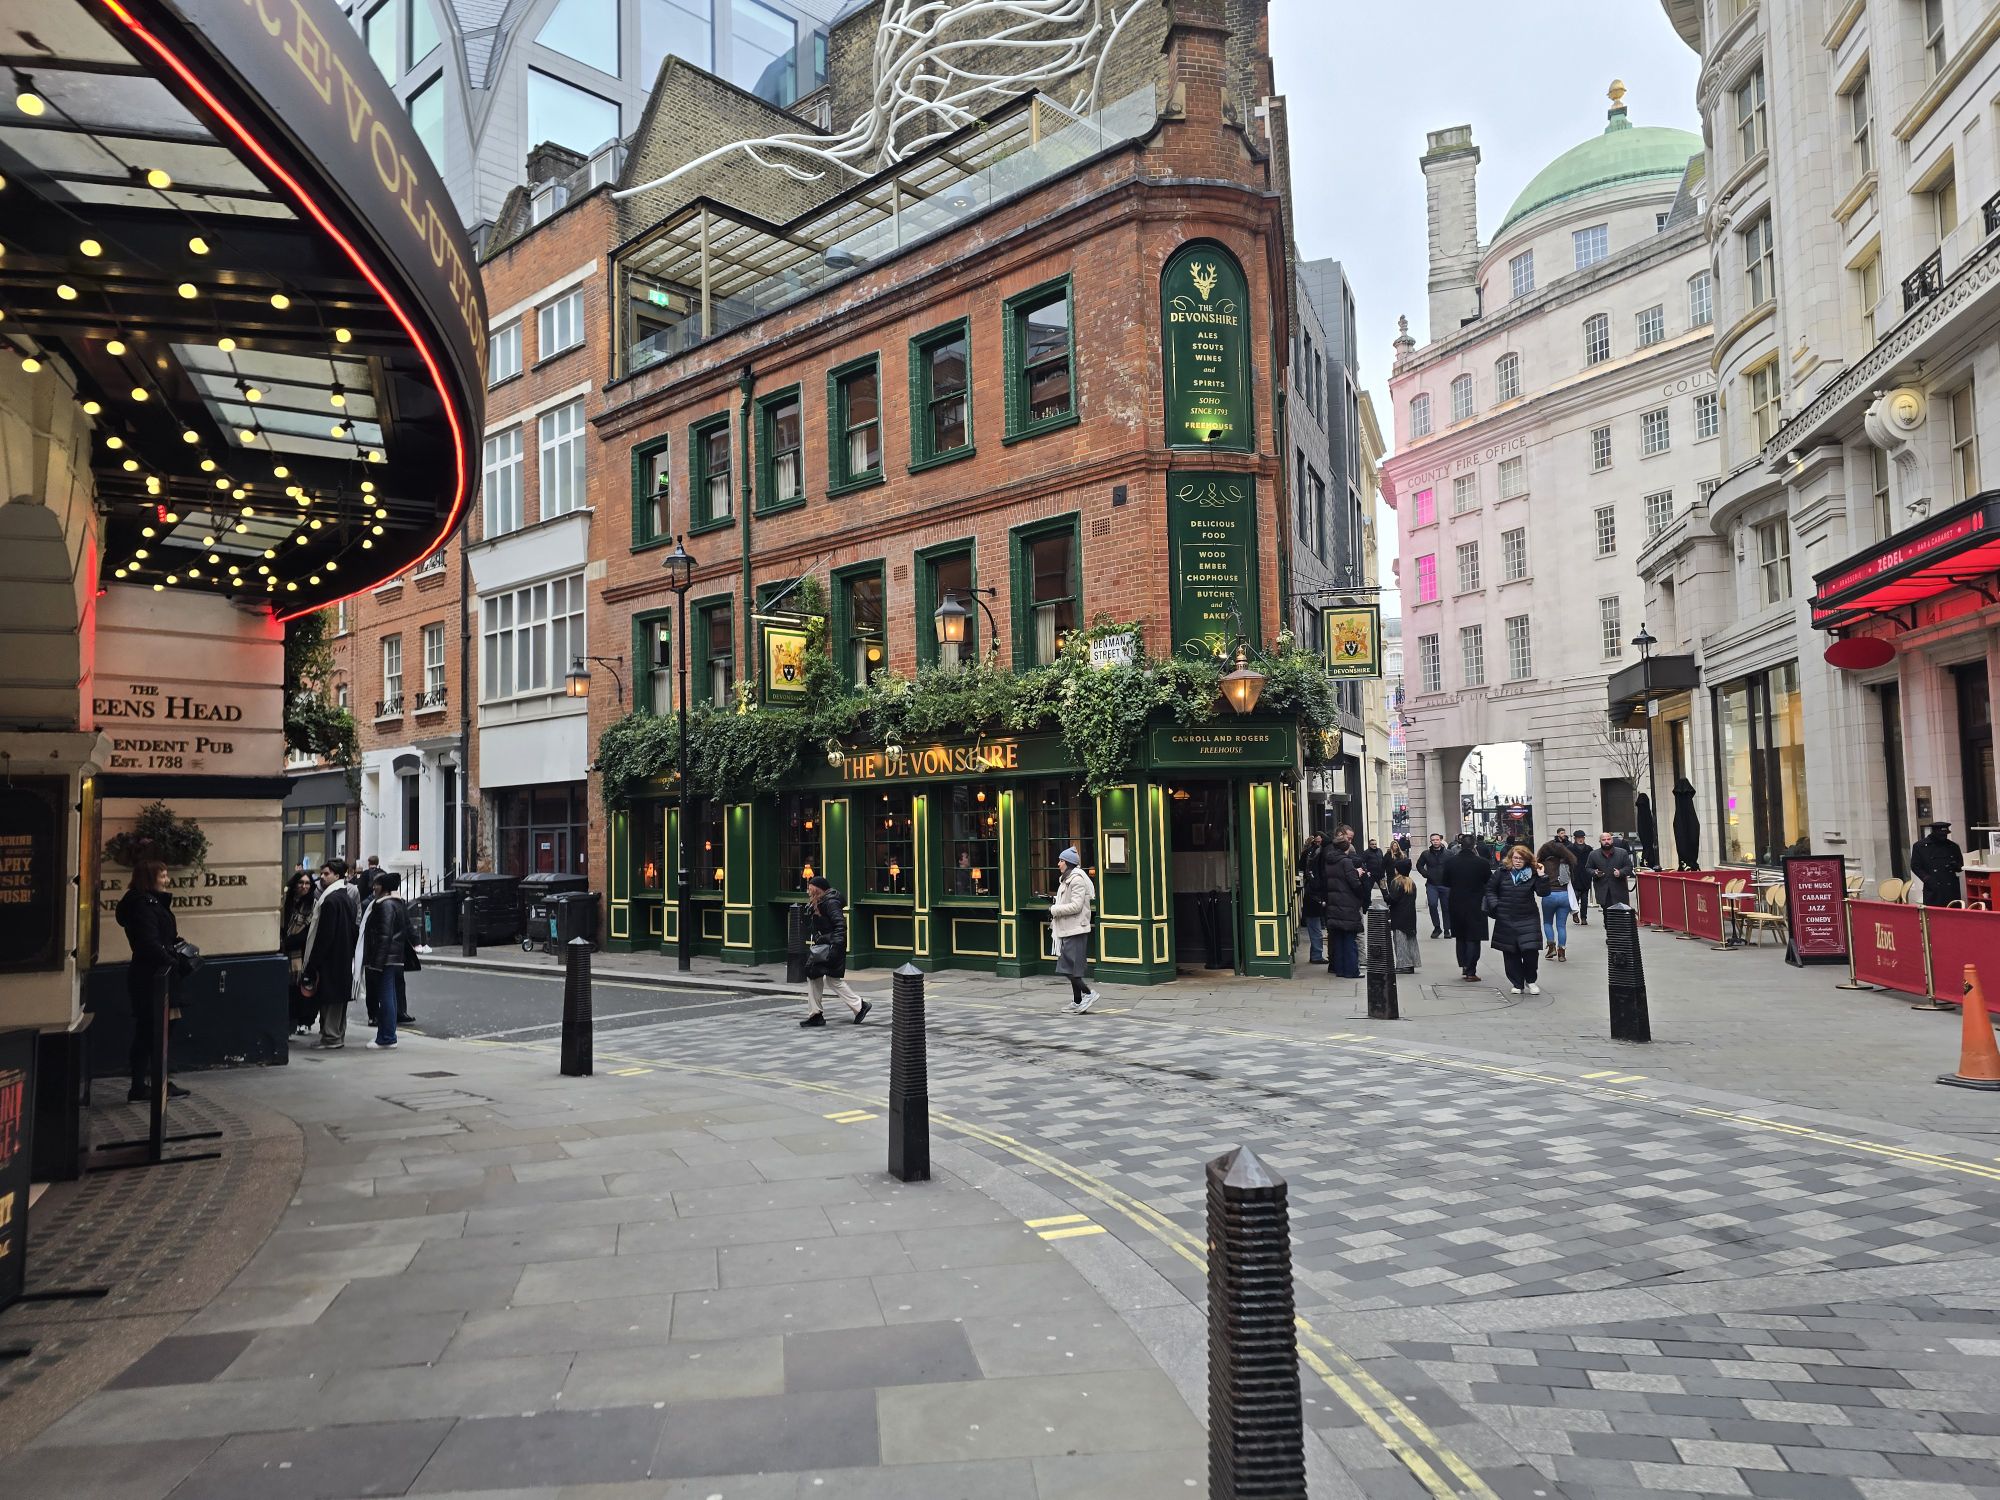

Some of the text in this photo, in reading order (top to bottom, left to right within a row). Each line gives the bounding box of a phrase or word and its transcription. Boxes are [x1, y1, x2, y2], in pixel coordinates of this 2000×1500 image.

[243, 0, 488, 380] EVOLUTION
[1198, 304, 1213, 312] THE
[1170, 312, 1238, 326] DEVONSHIRE
[1192, 343, 1224, 351] STOUTS
[1195, 354, 1222, 362] WINES
[1193, 379, 1225, 388] SPIRITS
[1190, 407, 1212, 415] SINCE
[1185, 421, 1233, 430] FREEHOUSE
[1408, 435, 1527, 488] COUNTY FIRE OFFICE
[1190, 520, 1235, 528] DELICIOUS
[1877, 549, 1904, 573] ZÉDEL
[1931, 529, 1953, 546] CABARET
[1199, 562, 1227, 570] EMBER
[1186, 574, 1239, 582] CHOPHOUSE
[1093, 636, 1126, 650] DENMAN
[1093, 648, 1120, 660] STREET
[1333, 667, 1371, 675] DEVONSHIRE
[130, 684, 159, 696] THE
[1470, 692, 1489, 702] LIFE
[165, 696, 242, 722] HEAD
[1171, 735, 1211, 743] CARROLL
[113, 737, 234, 754] ENDENT PUB
[1200, 746, 1243, 754] FREEHOUSE
[148, 755, 183, 769] 1738
[843, 755, 876, 780] THE
[204, 873, 248, 888] BEER
